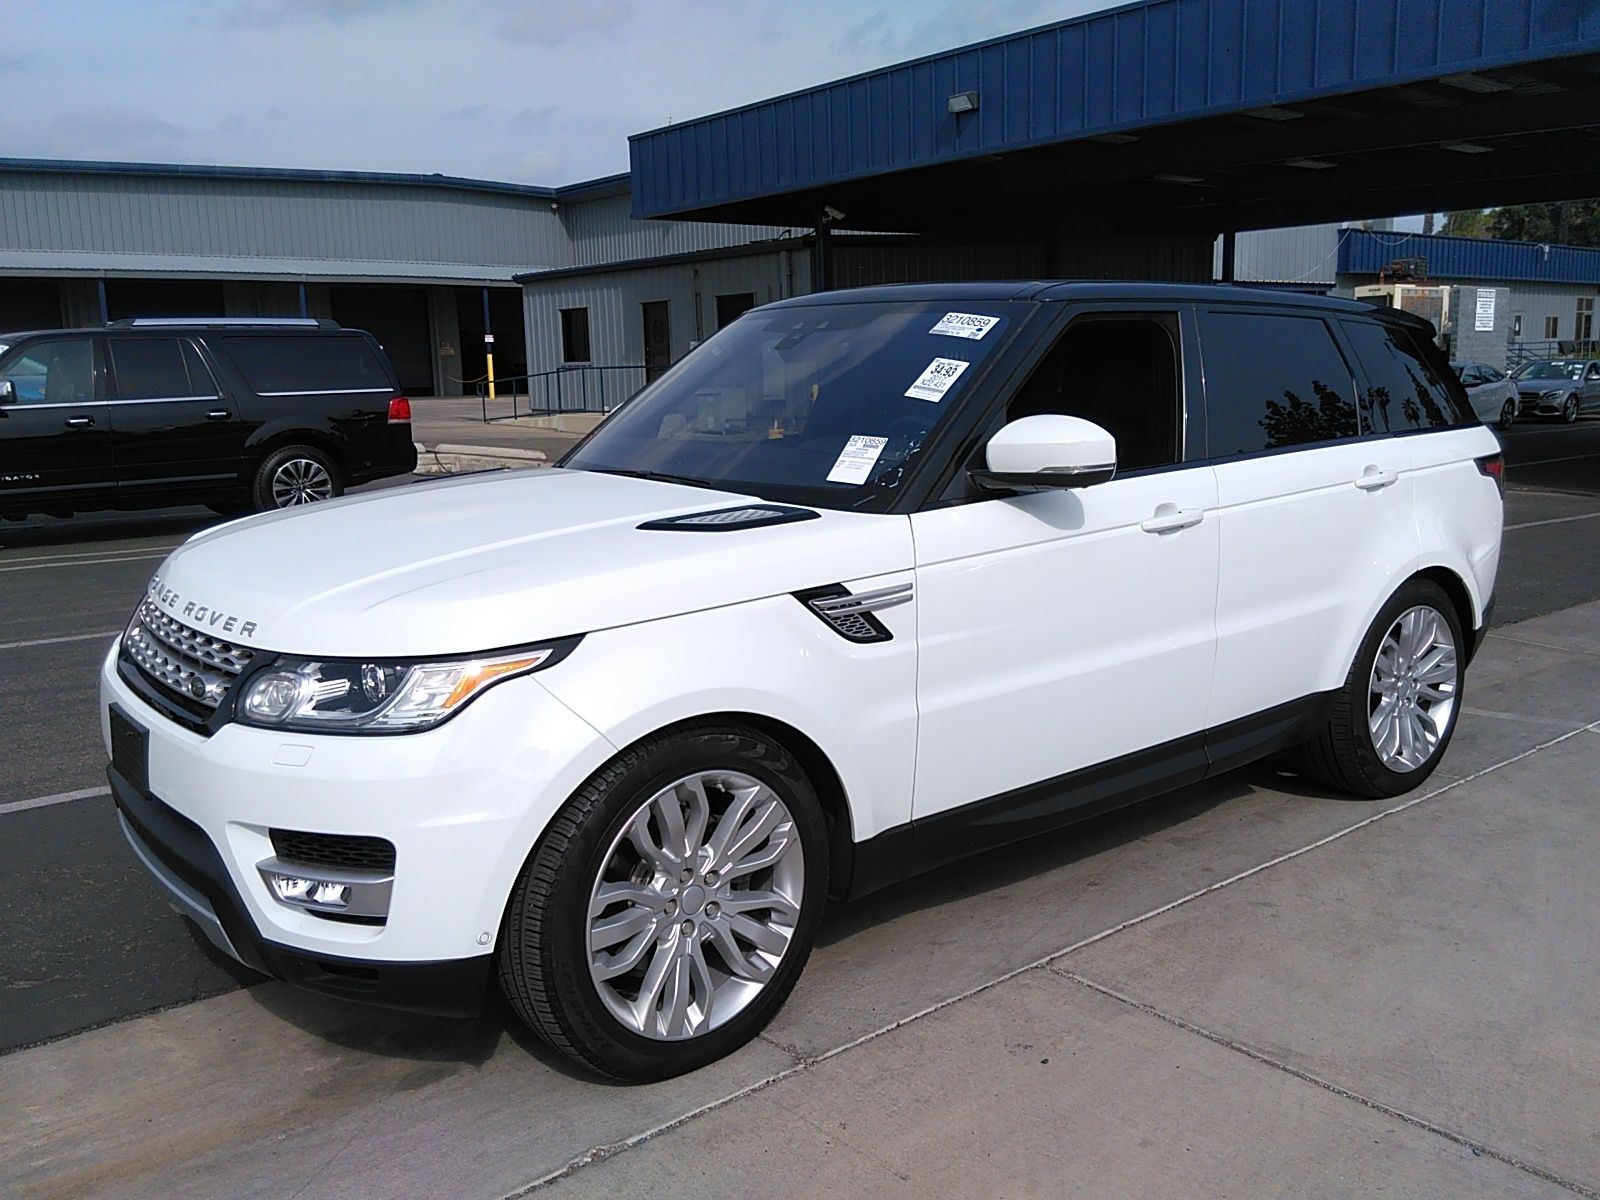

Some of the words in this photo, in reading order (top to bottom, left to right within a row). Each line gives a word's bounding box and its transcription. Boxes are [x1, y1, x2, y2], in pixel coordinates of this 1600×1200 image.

[941, 314, 992, 328] 3210859
[849, 436, 887, 445] 3210859
[182, 600, 258, 638] ROVER
